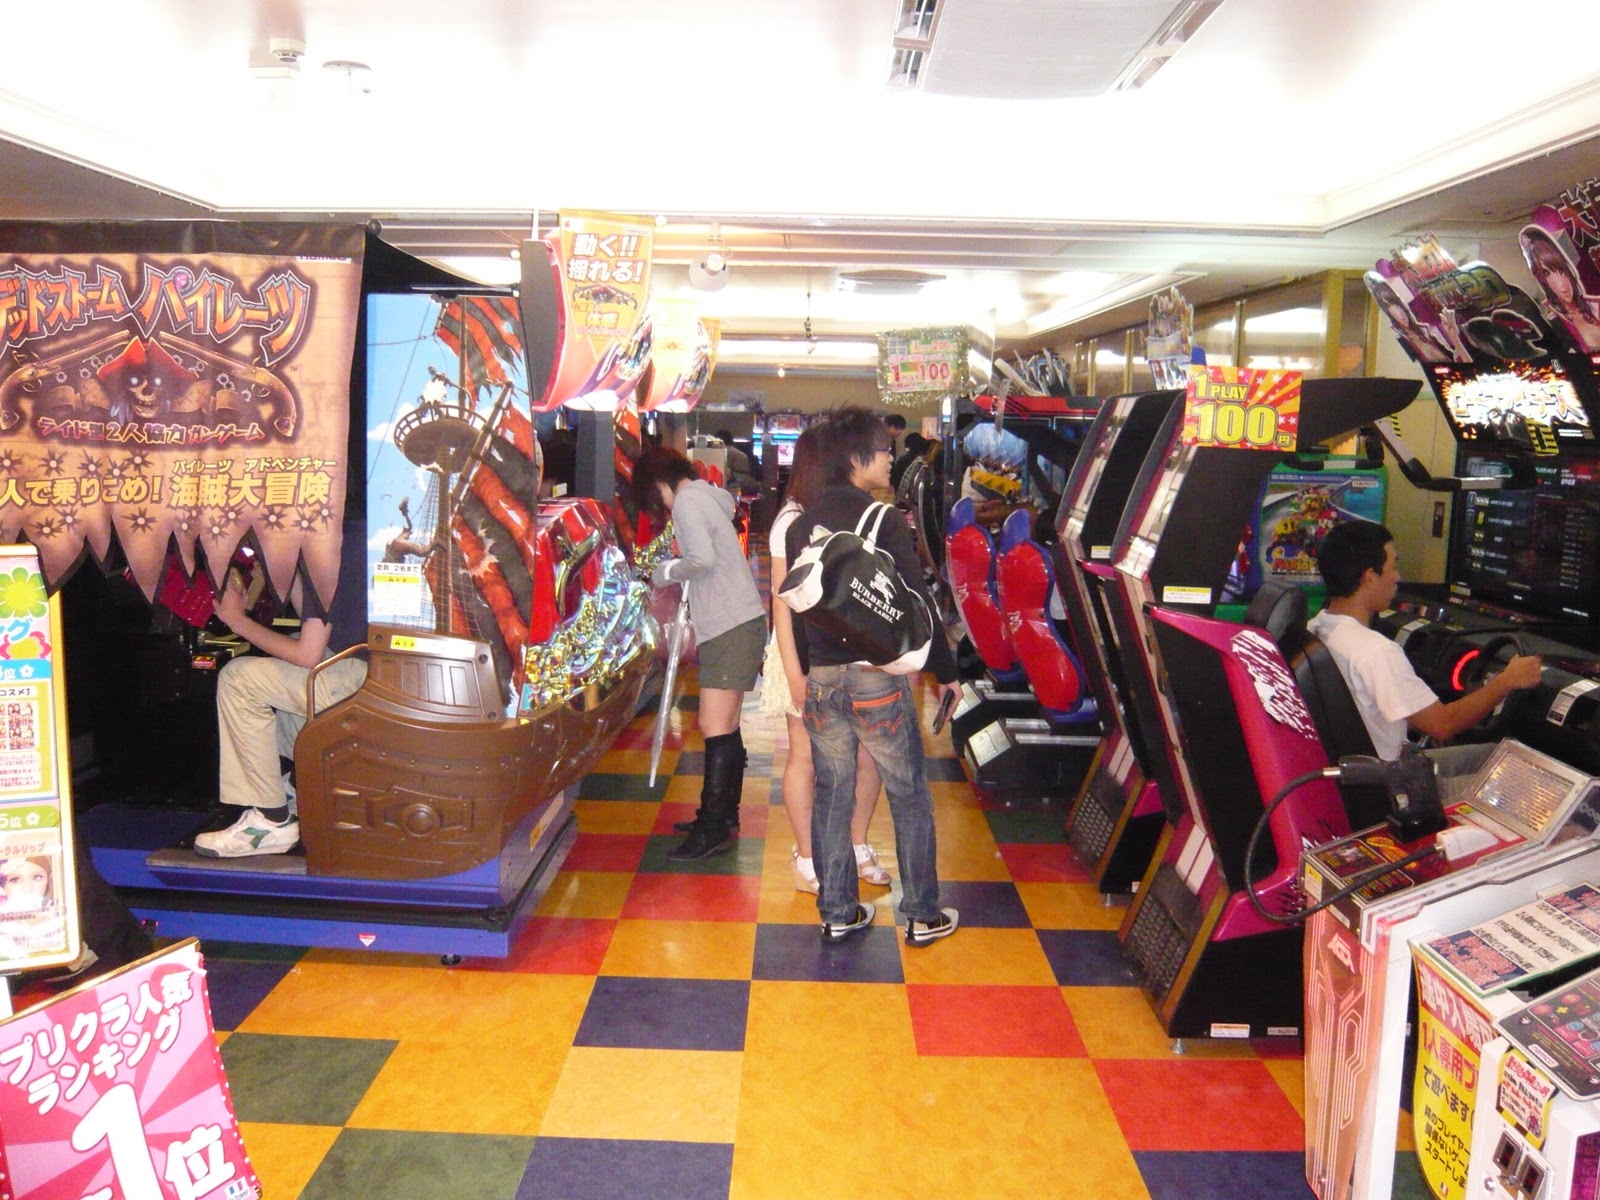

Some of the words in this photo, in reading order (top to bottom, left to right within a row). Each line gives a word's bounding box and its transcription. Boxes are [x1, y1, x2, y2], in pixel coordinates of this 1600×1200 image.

[134, 266, 308, 358] パイレーツ
[919, 362, 951, 380] 100
[1193, 373, 1208, 398] 1
[1209, 385, 1248, 400] PLAY
[173, 458, 233, 473] パイレーツ
[244, 456, 337, 472] アドベンチャー
[171, 471, 332, 508] 海賊大冒険
[850, 576, 904, 621] BURBERRY
[852, 591, 873, 609] BLACK
[873, 606, 894, 624] LABEL
[0, 970, 194, 1084] プリクラ人気
[28, 1006, 182, 1116] ランキング
